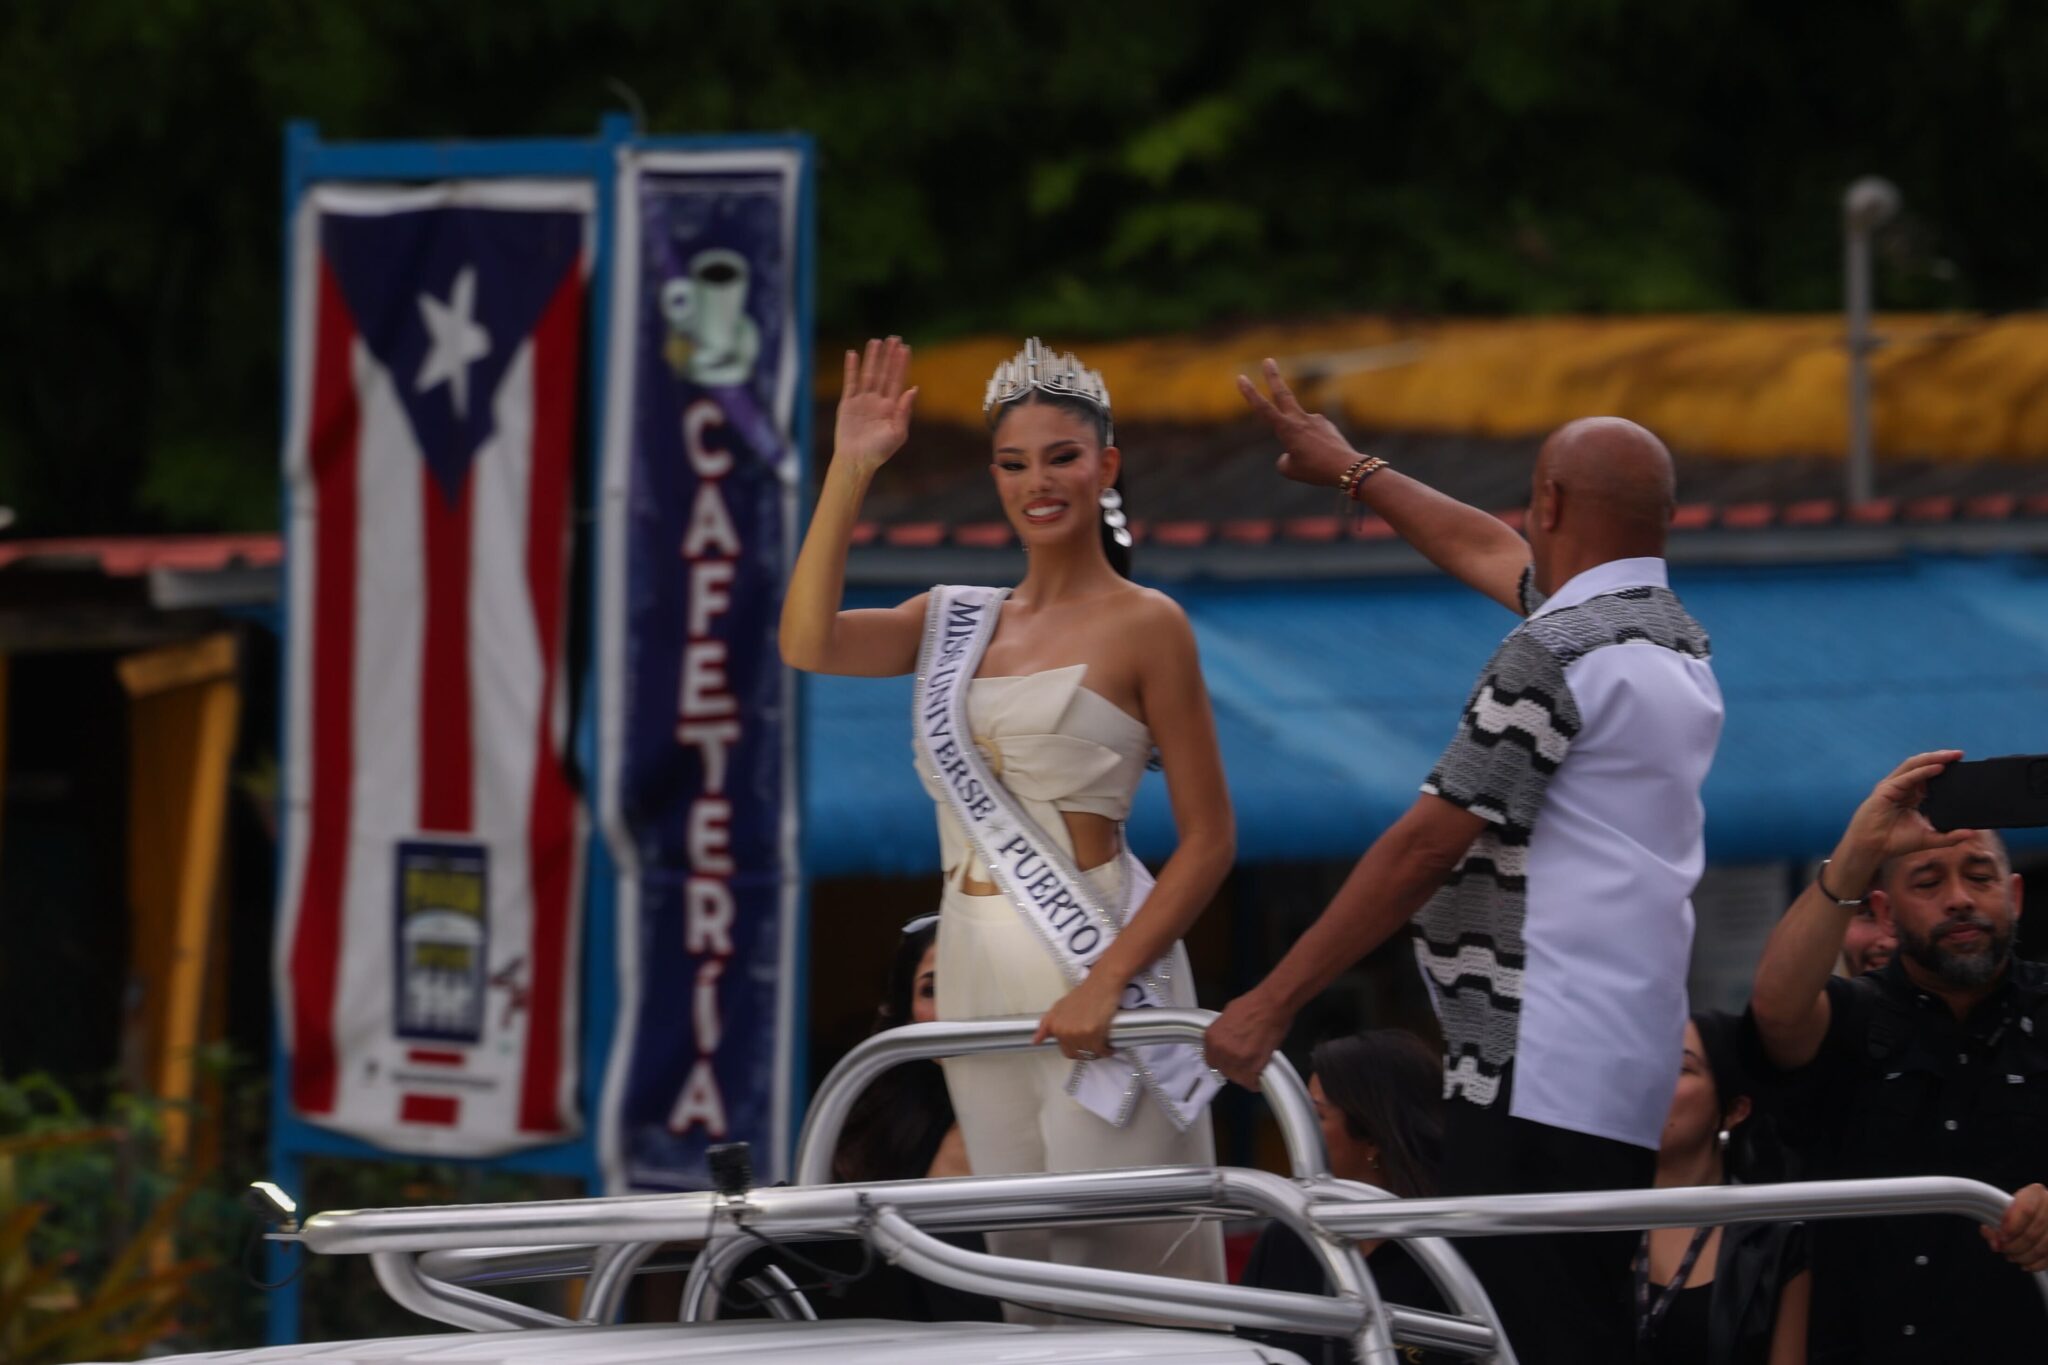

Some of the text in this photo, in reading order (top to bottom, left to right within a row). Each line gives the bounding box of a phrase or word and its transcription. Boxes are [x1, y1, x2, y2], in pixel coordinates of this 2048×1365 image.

[924, 600, 1101, 955] MISS UNIVERSE PUERTO
